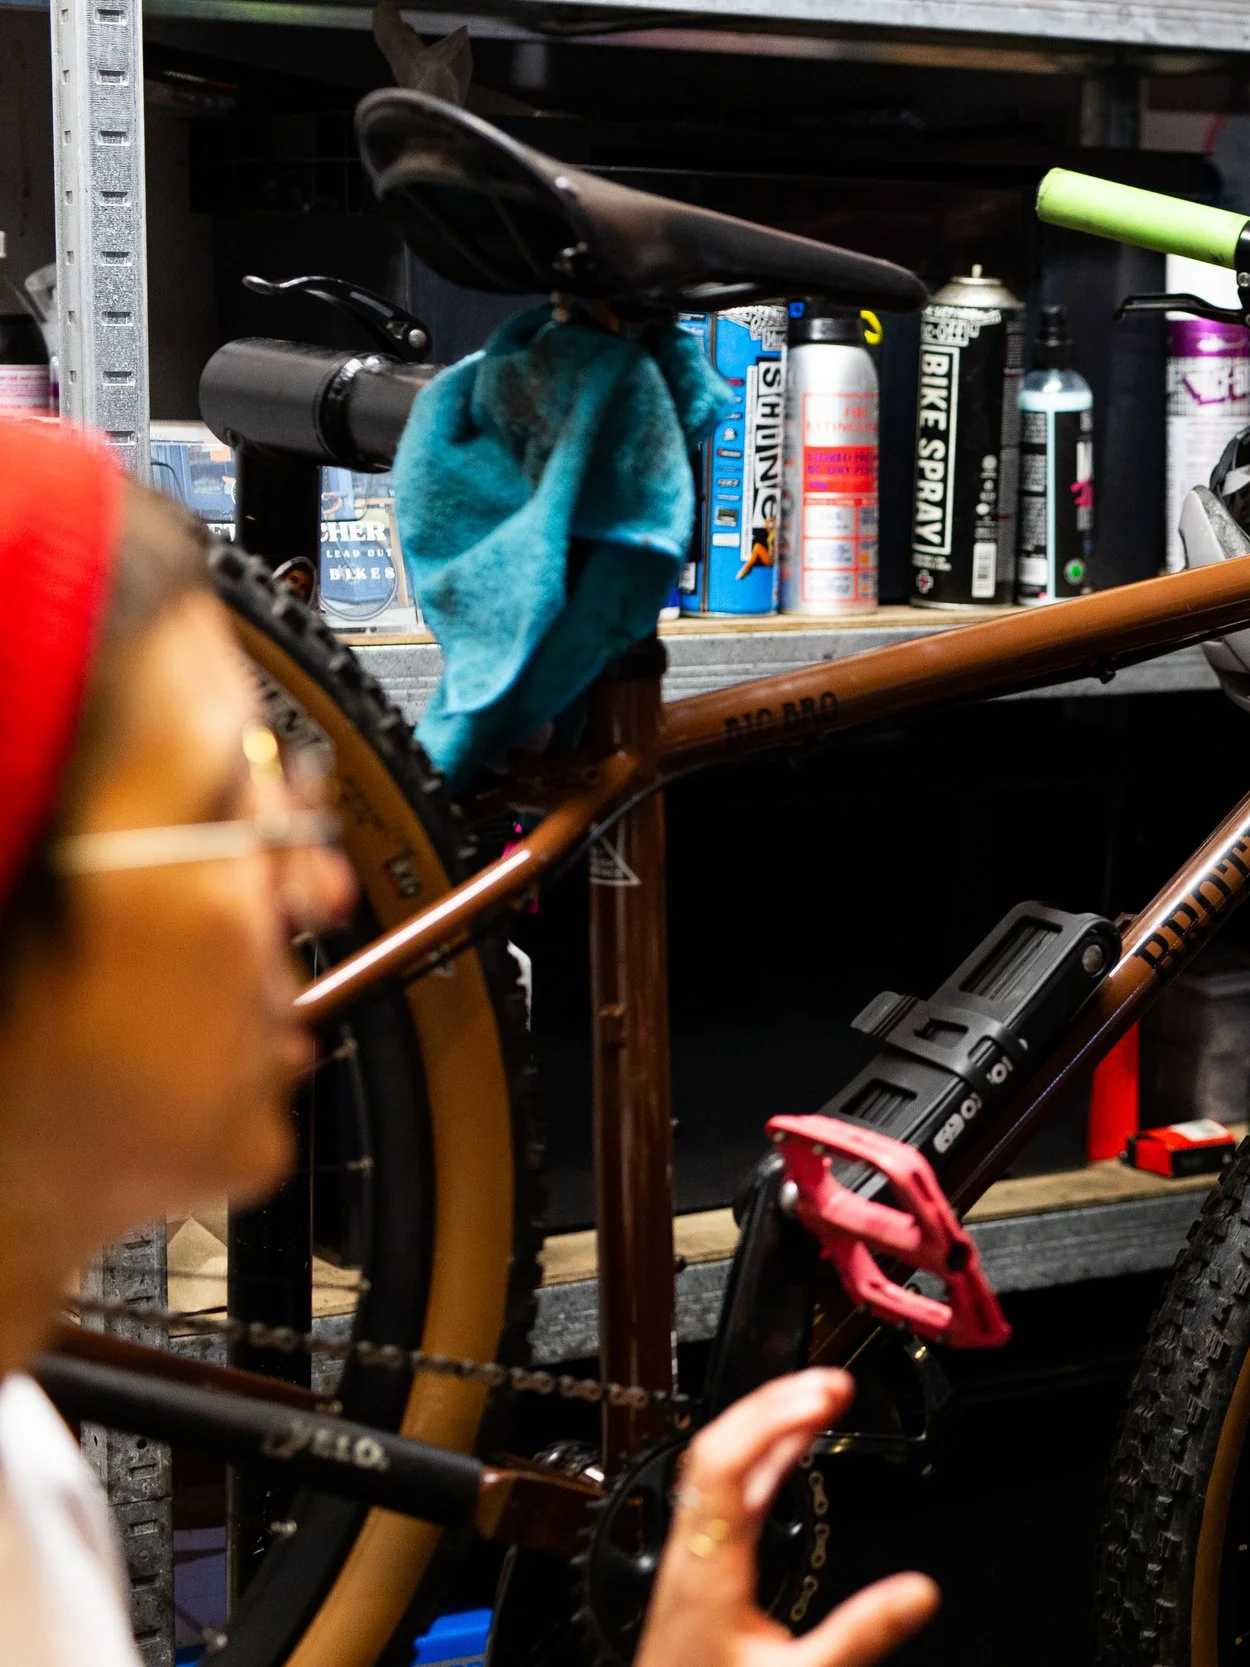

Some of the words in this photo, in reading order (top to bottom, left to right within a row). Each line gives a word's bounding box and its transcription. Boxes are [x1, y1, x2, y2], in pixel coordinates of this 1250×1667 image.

[920, 353, 950, 432] BIKE
[915, 437, 947, 546] SPRAY
[326, 549, 361, 559] LEAD
[367, 548, 393, 558] OUT
[329, 567, 396, 581] BIKES
